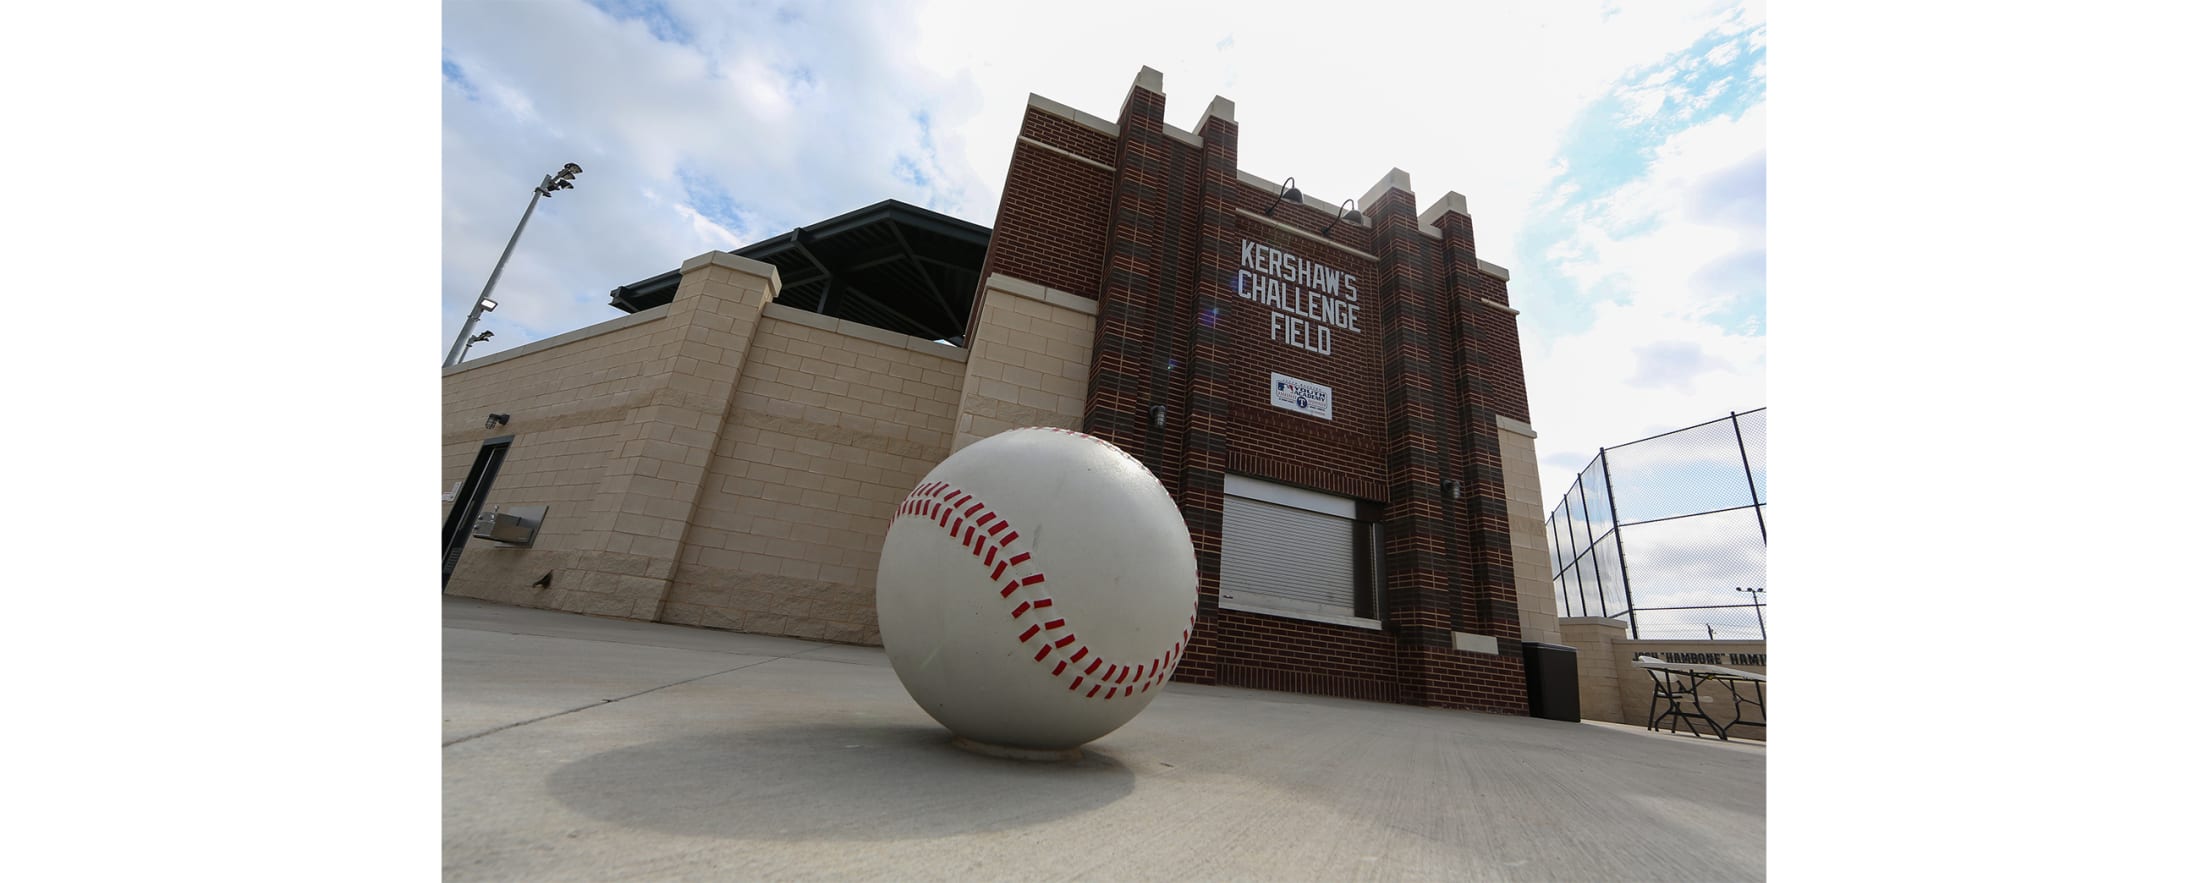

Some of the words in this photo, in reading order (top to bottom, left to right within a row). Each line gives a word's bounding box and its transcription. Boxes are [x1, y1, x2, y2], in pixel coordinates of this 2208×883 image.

[1238, 269, 1361, 333] CHALLENGE
[1241, 238, 1358, 302] KERSHAW'S
[1271, 311, 1332, 356] FIELD
